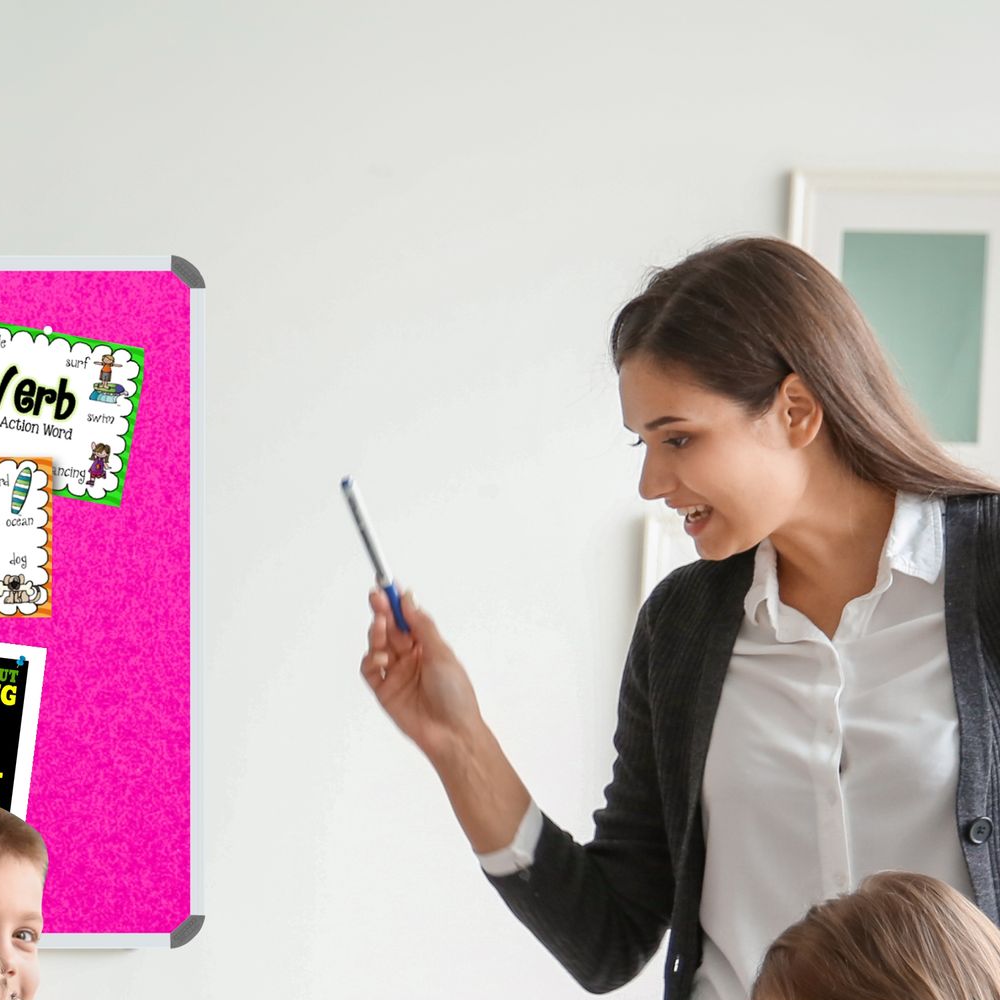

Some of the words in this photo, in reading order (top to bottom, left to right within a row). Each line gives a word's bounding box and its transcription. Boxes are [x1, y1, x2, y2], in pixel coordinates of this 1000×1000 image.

[66, 357, 90, 369] surf
[87, 412, 115, 424] swim
[0, 417, 39, 434] Action
[43, 425, 72, 440] Word
[52, 466, 86, 485] ancing
[6, 516, 34, 527] ocean
[10, 553, 27, 569] dog
